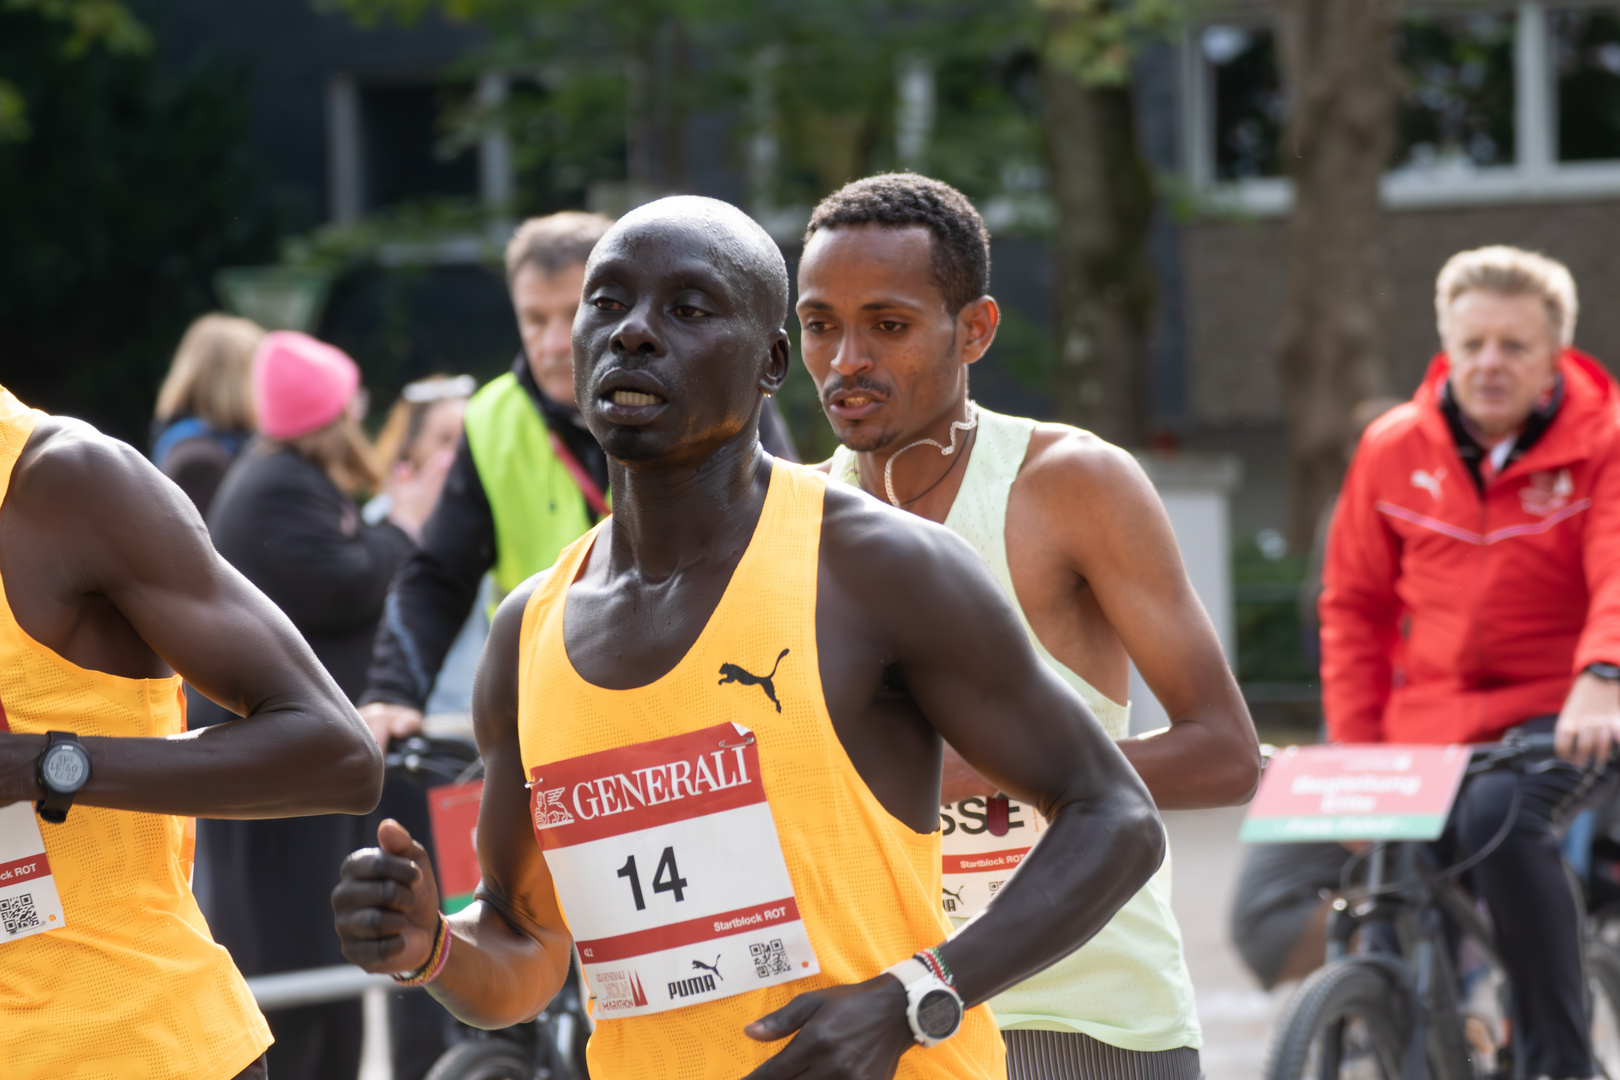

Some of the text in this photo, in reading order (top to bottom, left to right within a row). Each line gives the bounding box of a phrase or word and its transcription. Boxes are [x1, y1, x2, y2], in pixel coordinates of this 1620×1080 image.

[572, 745, 752, 820] GENERALI
[15, 863, 37, 876] ROT
[960, 854, 1025, 869] Startblock ROT
[616, 846, 688, 911] 14
[713, 907, 787, 932] Startblock ROT
[667, 974, 717, 1000] PUMA
[602, 999, 635, 1011] MARATHON
